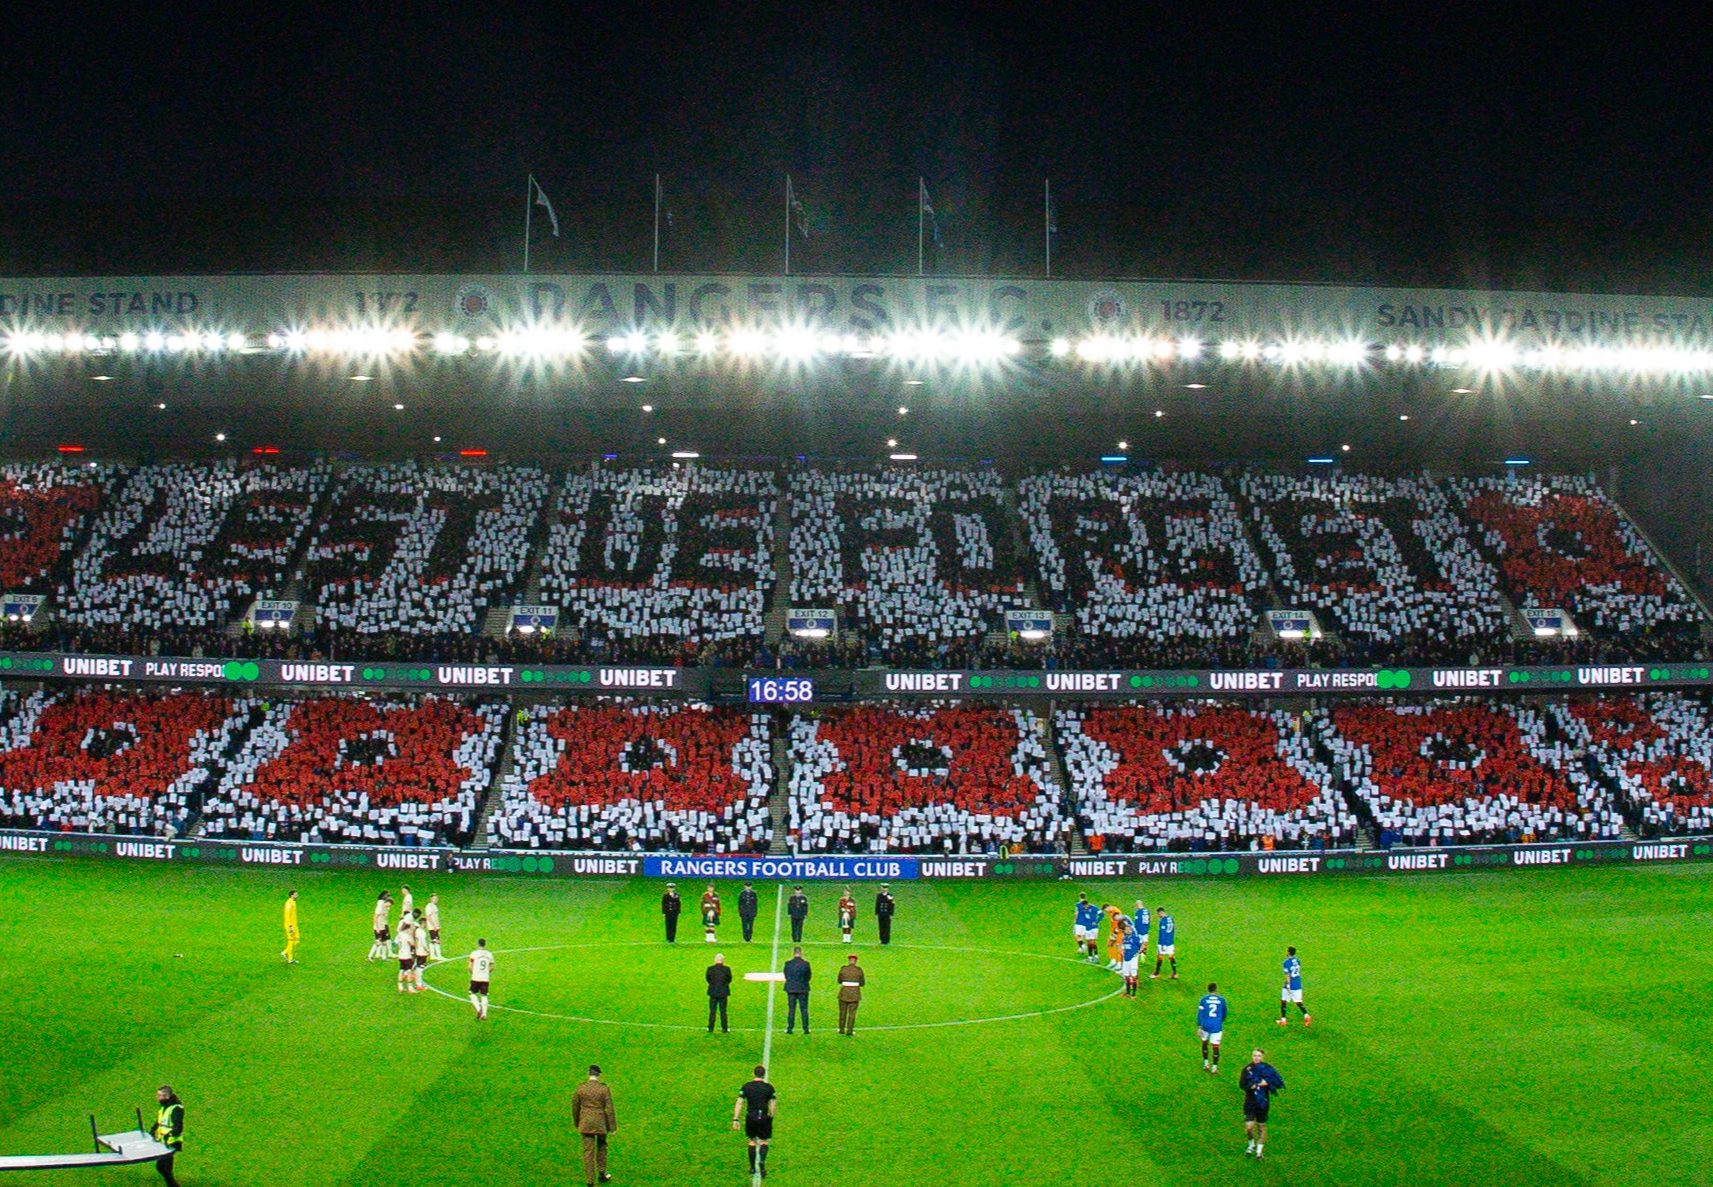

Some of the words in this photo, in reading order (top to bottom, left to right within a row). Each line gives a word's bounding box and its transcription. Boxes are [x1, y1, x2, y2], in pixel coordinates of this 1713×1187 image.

[87, 291, 200, 316] STAND
[1161, 300, 1225, 322] 1872
[1377, 303, 1483, 329] SANDY
[261, 601, 280, 609] EXIT
[63, 657, 133, 676] UNIBET
[145, 661, 178, 676] PLAY
[281, 664, 355, 682] UNIBET
[438, 666, 514, 685] UNIBET
[599, 669, 677, 688] UNIBET
[885, 673, 963, 691] UNIBET
[1046, 673, 1122, 690] UNIBET
[1209, 672, 1284, 690] UNIBET
[1296, 673, 1330, 687] PLAY
[1432, 669, 1503, 687] UNIBET
[1578, 667, 1645, 685] UNIBET
[750, 680, 813, 702] 16:58
[115, 842, 176, 859] UNIBET
[241, 848, 304, 864] UNIBET
[1513, 848, 1571, 865] UNIBET
[1632, 844, 1688, 860] UNIBET
[376, 854, 440, 869] UNIBET
[454, 857, 481, 870] PLAY
[573, 859, 639, 874] UNIBET
[660, 859, 747, 876] RANGERS
[751, 861, 849, 877] FOOTBALL
[853, 862, 901, 877] CLUB
[921, 862, 987, 877] UNIBET
[1138, 862, 1167, 874] PLAY
[1258, 857, 1320, 873] UNIBET
[1388, 853, 1448, 869] UNIBET
[1208, 1003, 1218, 1018] 2
